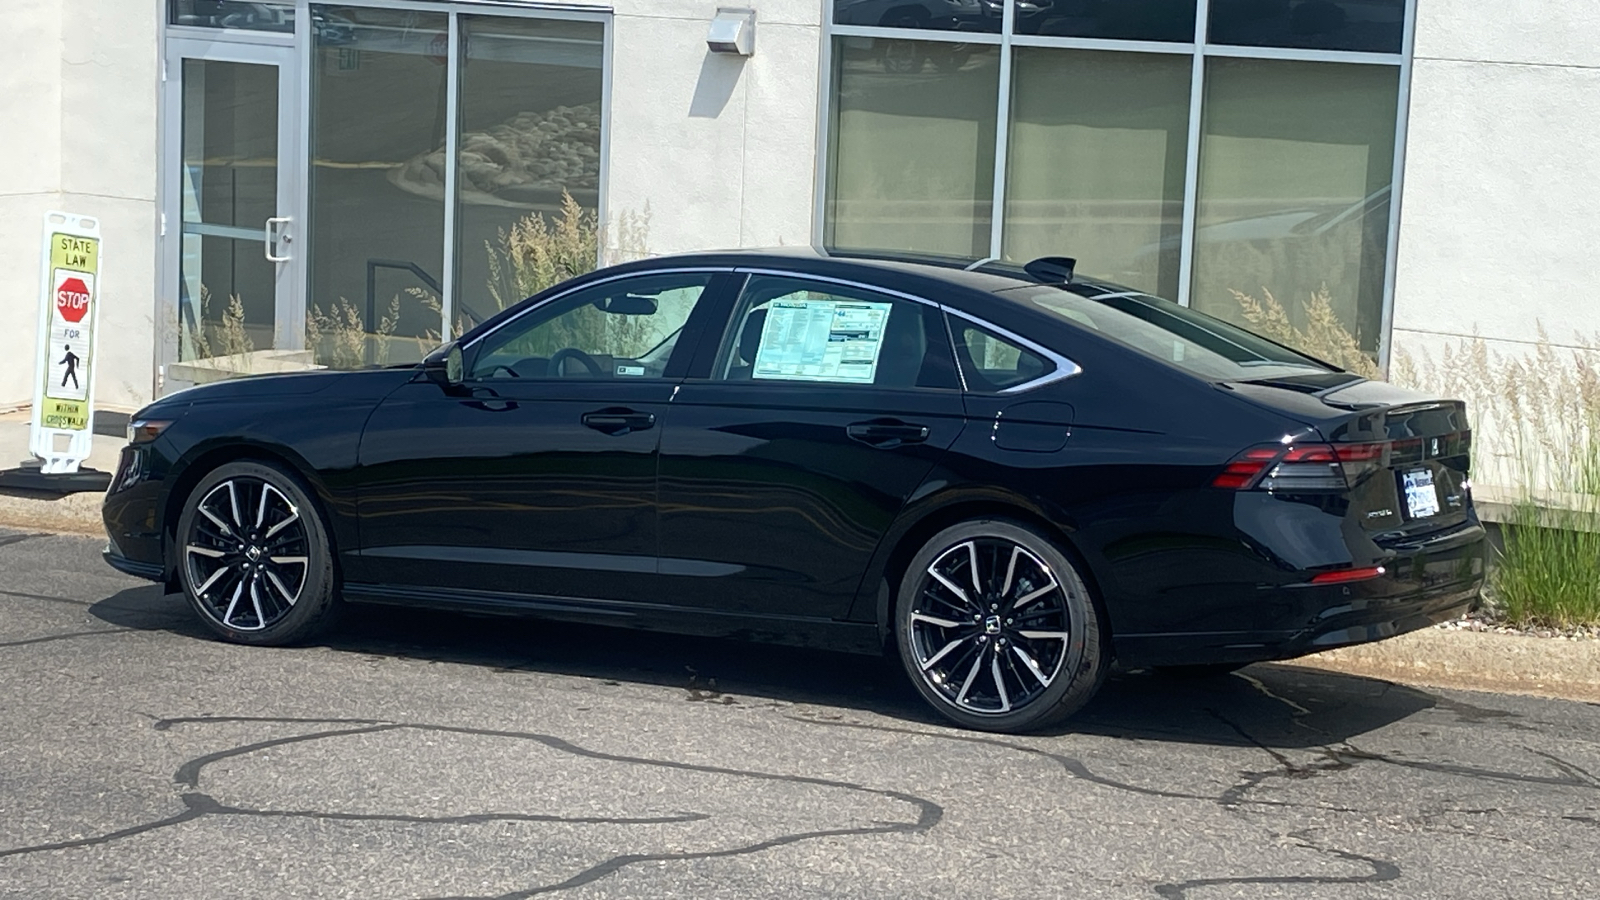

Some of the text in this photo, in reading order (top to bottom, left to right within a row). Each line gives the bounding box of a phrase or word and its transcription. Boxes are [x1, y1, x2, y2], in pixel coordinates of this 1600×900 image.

[61, 238, 91, 253] STATE
[66, 253, 86, 267] LAW
[58, 290, 89, 309] STOP
[64, 328, 81, 339] FOR
[56, 402, 80, 414] WITHIN
[46, 415, 84, 426] CROSSWALK
